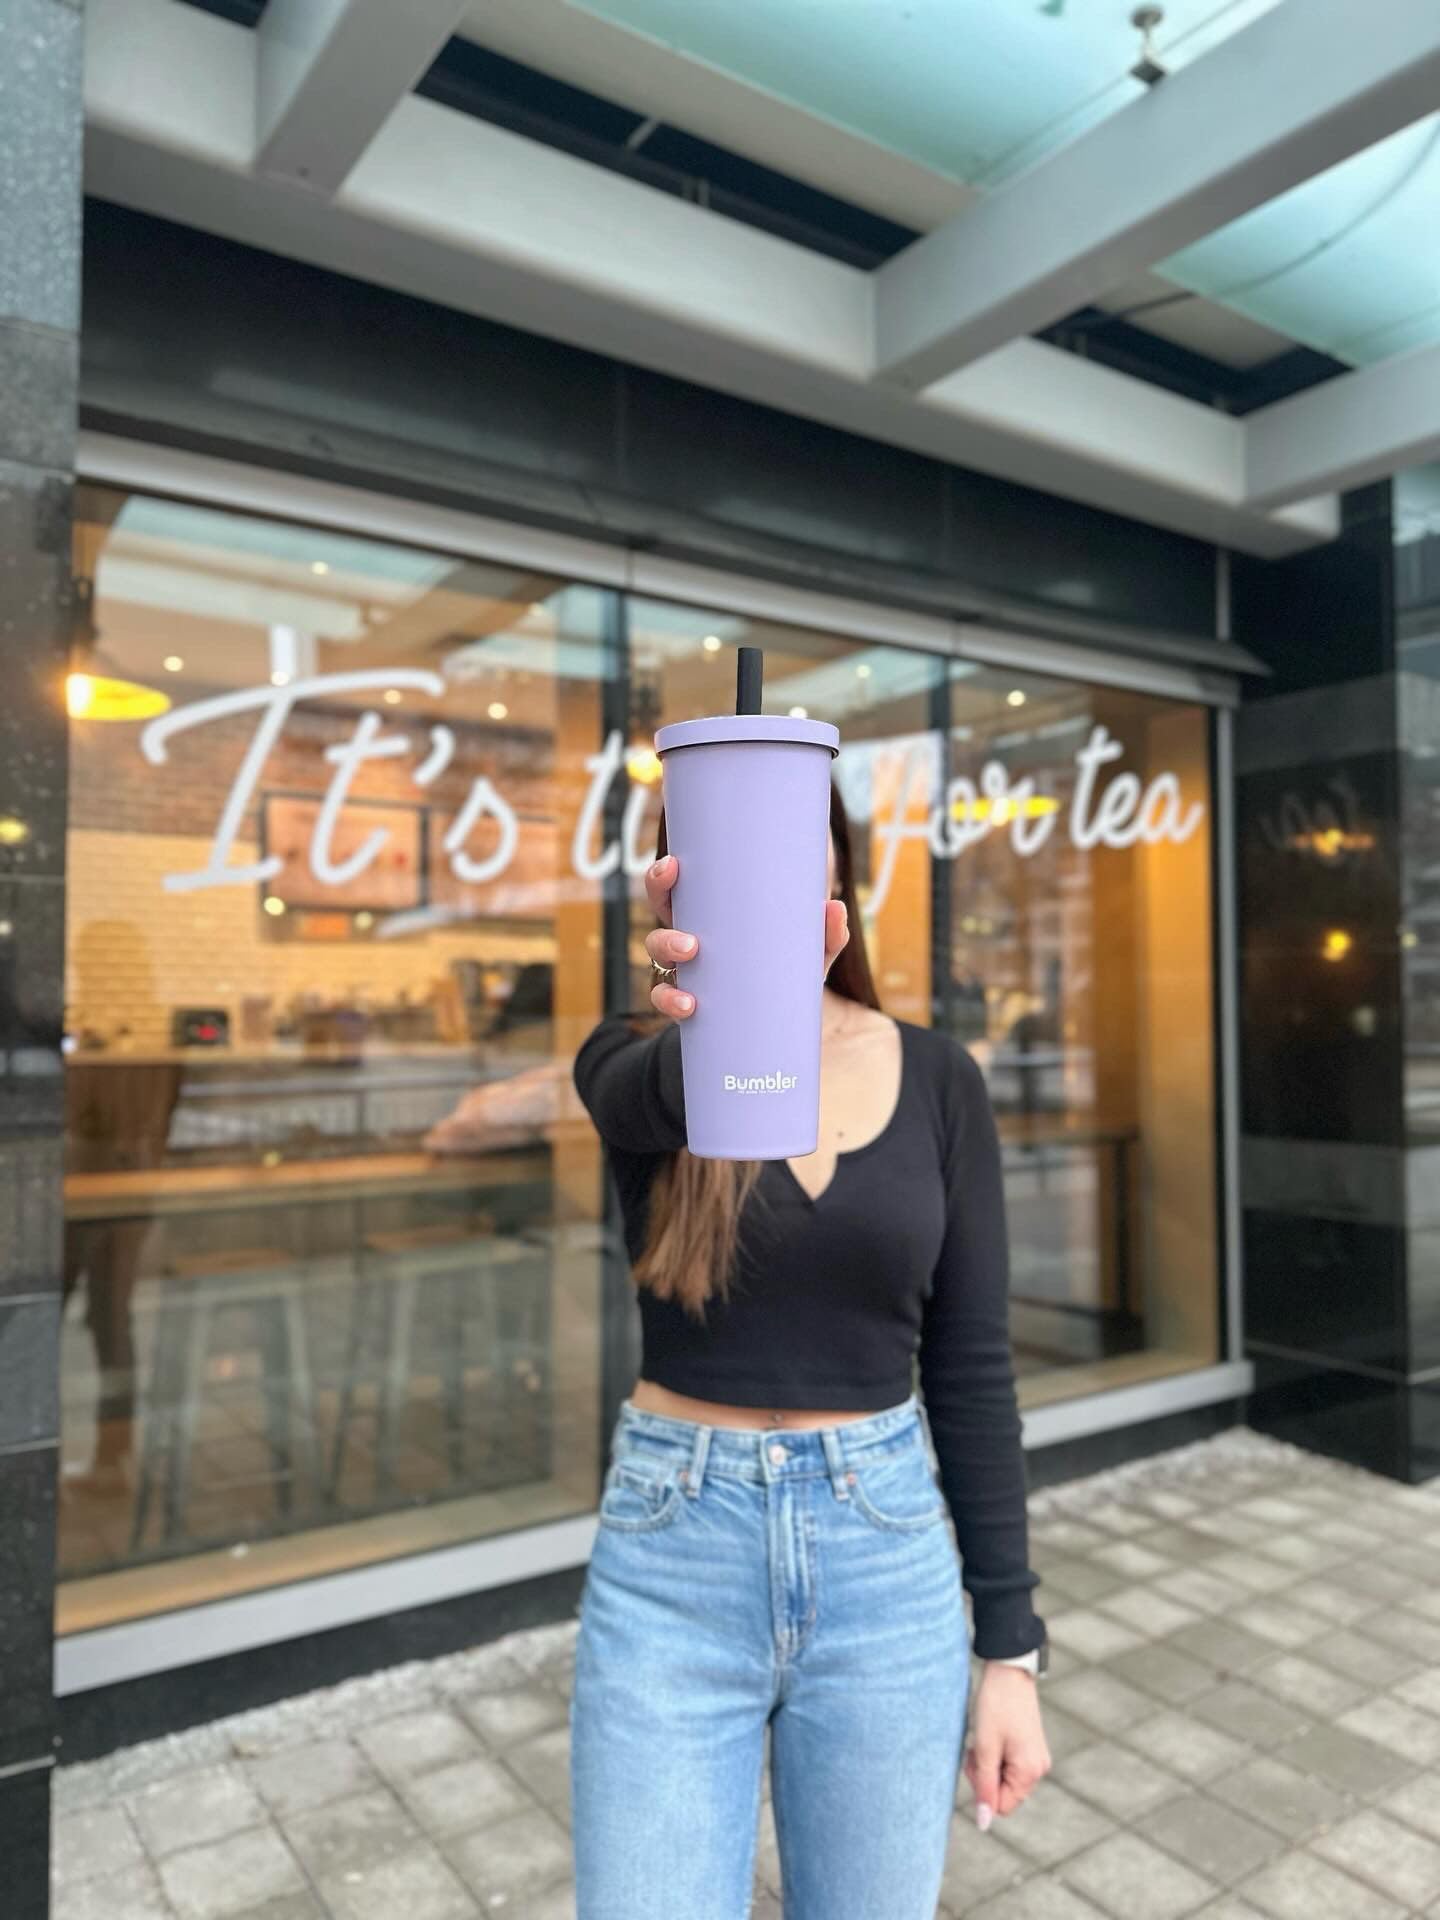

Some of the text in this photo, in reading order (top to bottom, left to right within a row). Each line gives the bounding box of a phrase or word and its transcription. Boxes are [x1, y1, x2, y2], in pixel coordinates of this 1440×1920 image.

[141, 669, 518, 892] It's
[863, 739, 1058, 917] for
[1069, 725, 1204, 851] tea
[724, 1070, 798, 1090] Bumbler
